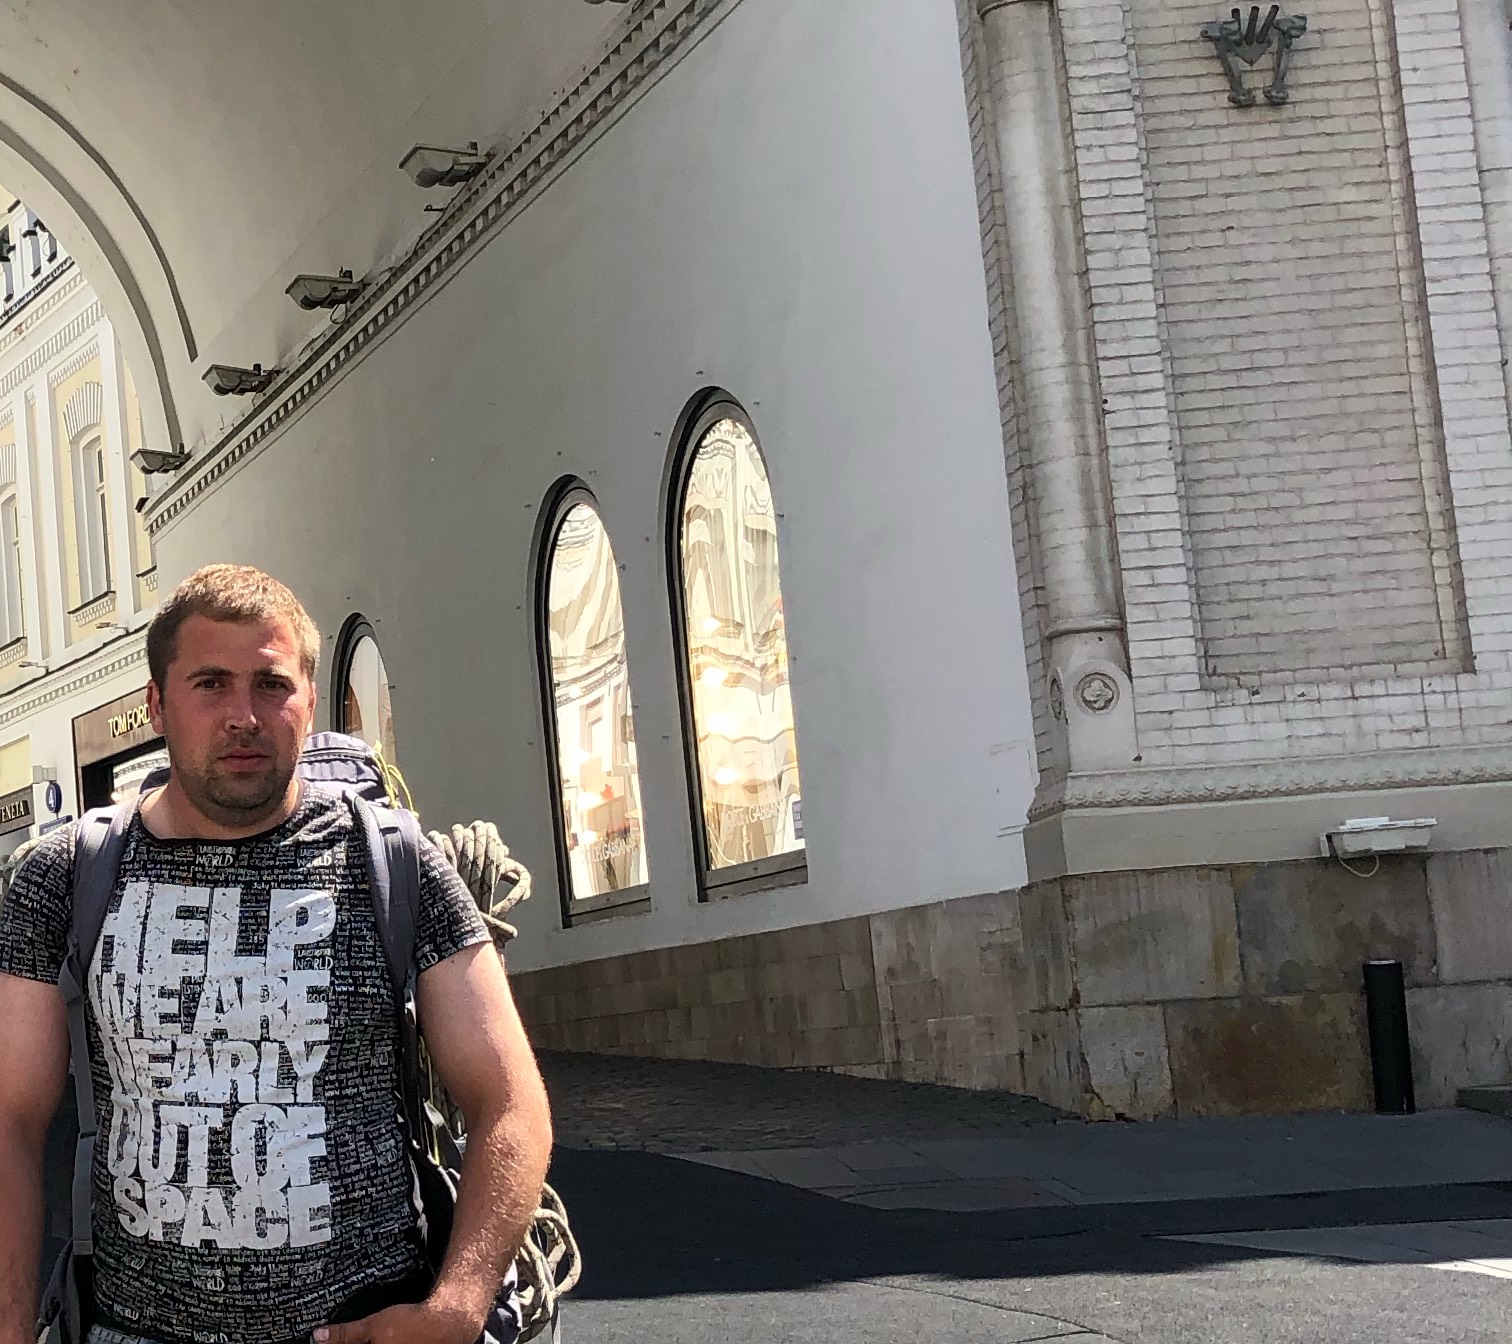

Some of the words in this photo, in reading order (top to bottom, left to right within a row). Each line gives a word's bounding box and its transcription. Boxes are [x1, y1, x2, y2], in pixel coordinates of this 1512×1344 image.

[108, 713, 127, 738] TOM
[127, 703, 151, 731] FORD
[48, 788, 55, 808] 4
[195, 853, 234, 869] WORLD
[89, 882, 336, 977] HELP
[294, 956, 334, 971] WORLD
[88, 973, 183, 1039] WE
[192, 970, 331, 1042] ARE
[101, 1037, 330, 1104] NEARLY
[108, 1099, 224, 1185] OUT
[231, 1103, 327, 1189] OF
[113, 1175, 332, 1250] SPACE
